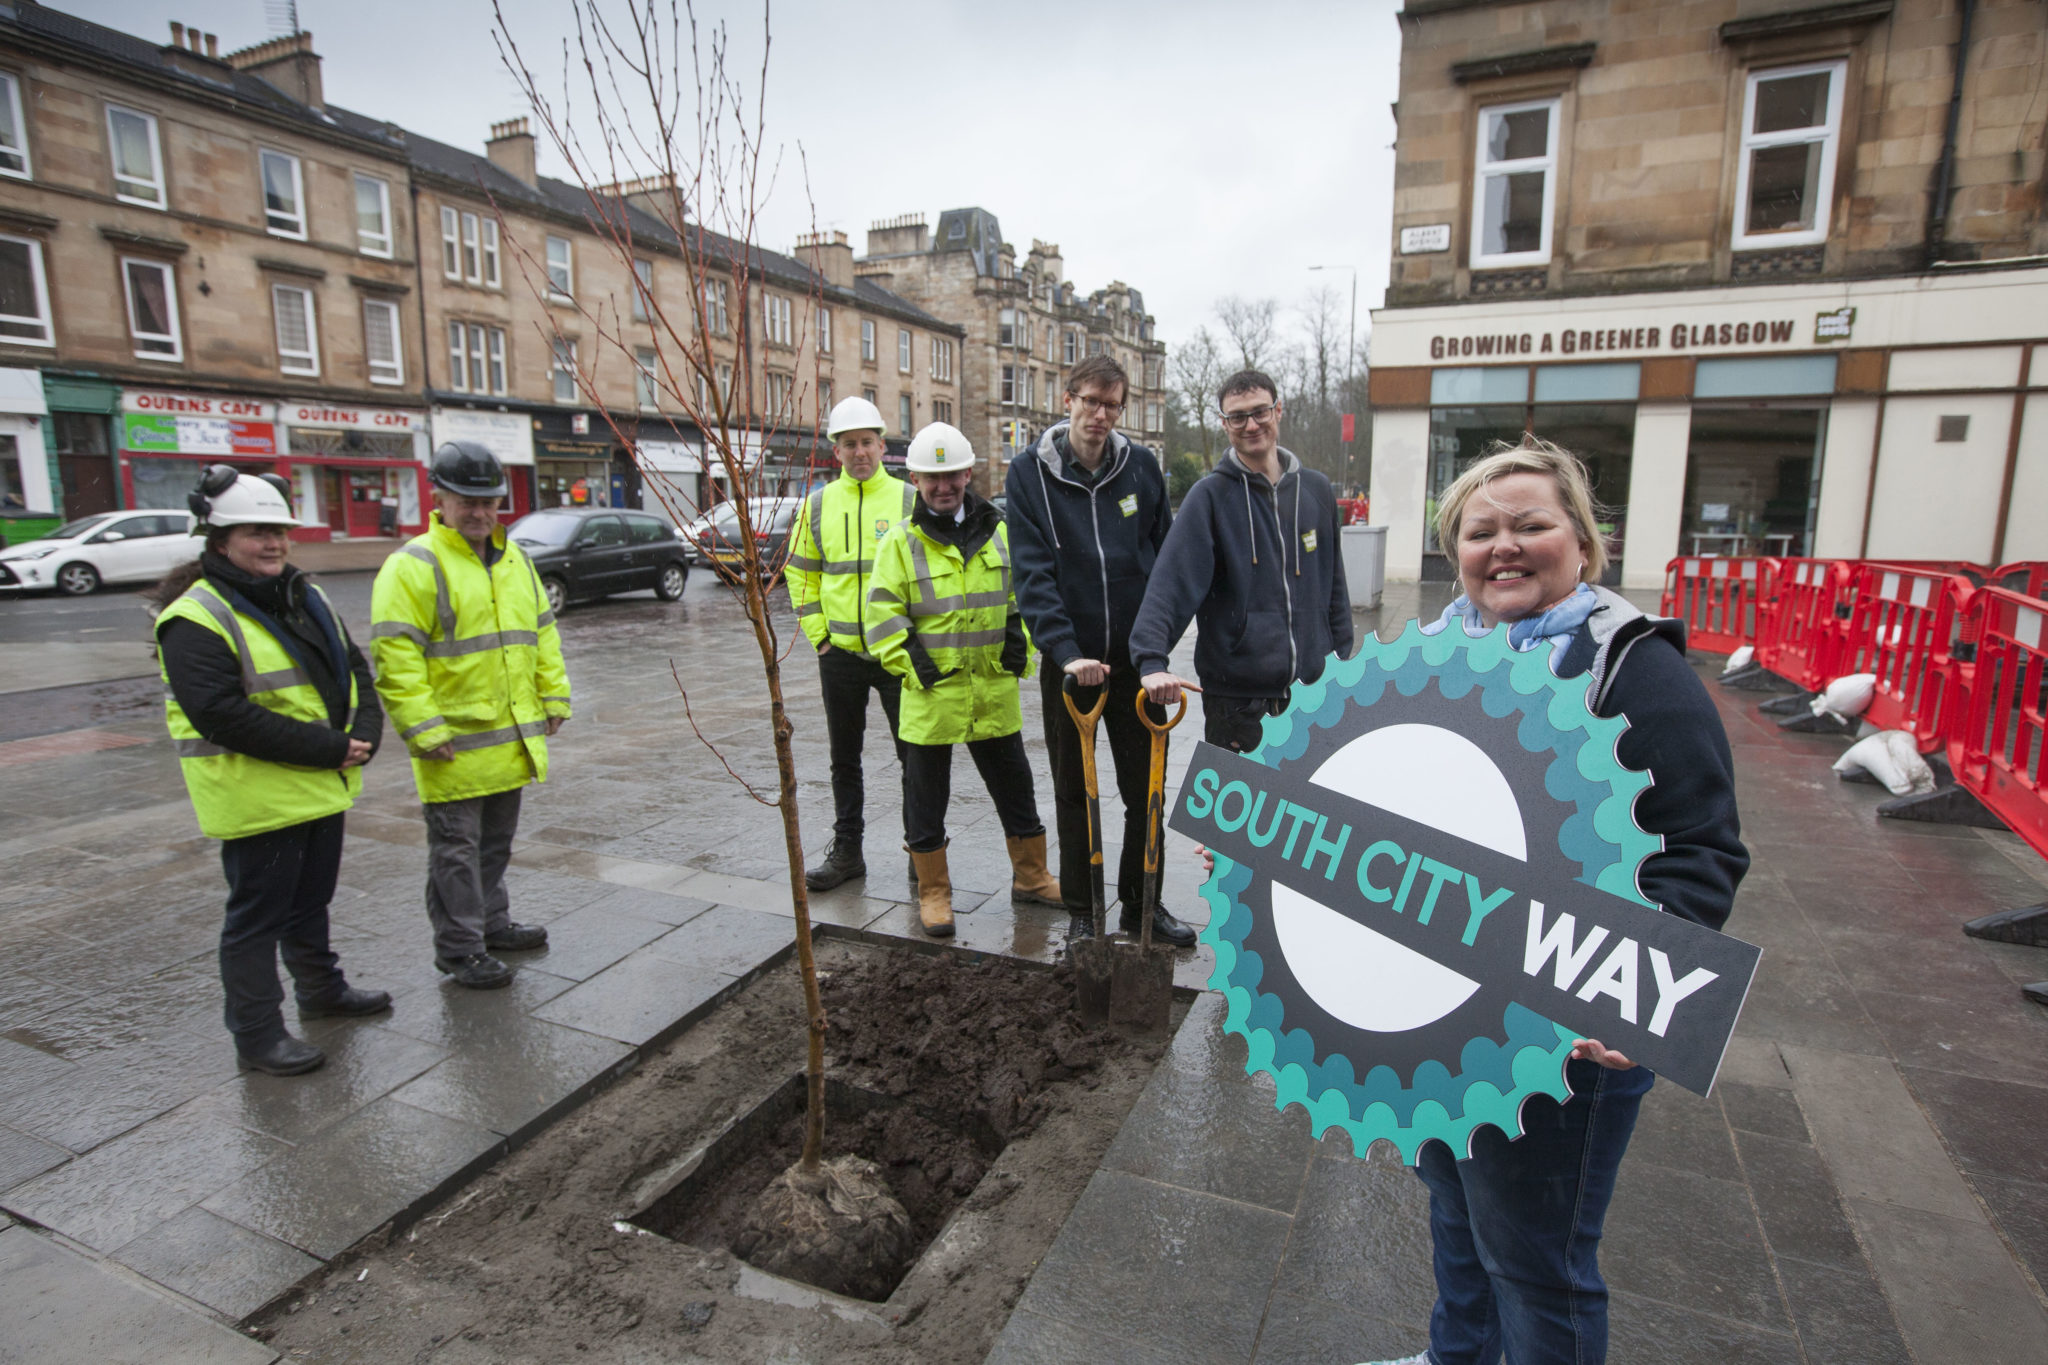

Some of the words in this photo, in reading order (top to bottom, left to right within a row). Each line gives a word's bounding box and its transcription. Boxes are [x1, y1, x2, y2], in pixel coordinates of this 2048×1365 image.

[1430, 333, 1533, 360] GROWING
[1540, 333, 1553, 353] A
[1561, 328, 1661, 354] GREENER
[1670, 320, 1795, 350] GLASGOW
[136, 394, 211, 414] QUEENS
[220, 400, 263, 417] CAFE
[297, 403, 359, 423] QUEENS
[374, 409, 410, 427] CAFE
[1186, 768, 1353, 881] SOUTH
[1356, 839, 1516, 947] CITY
[1523, 899, 1721, 1038] WAY
